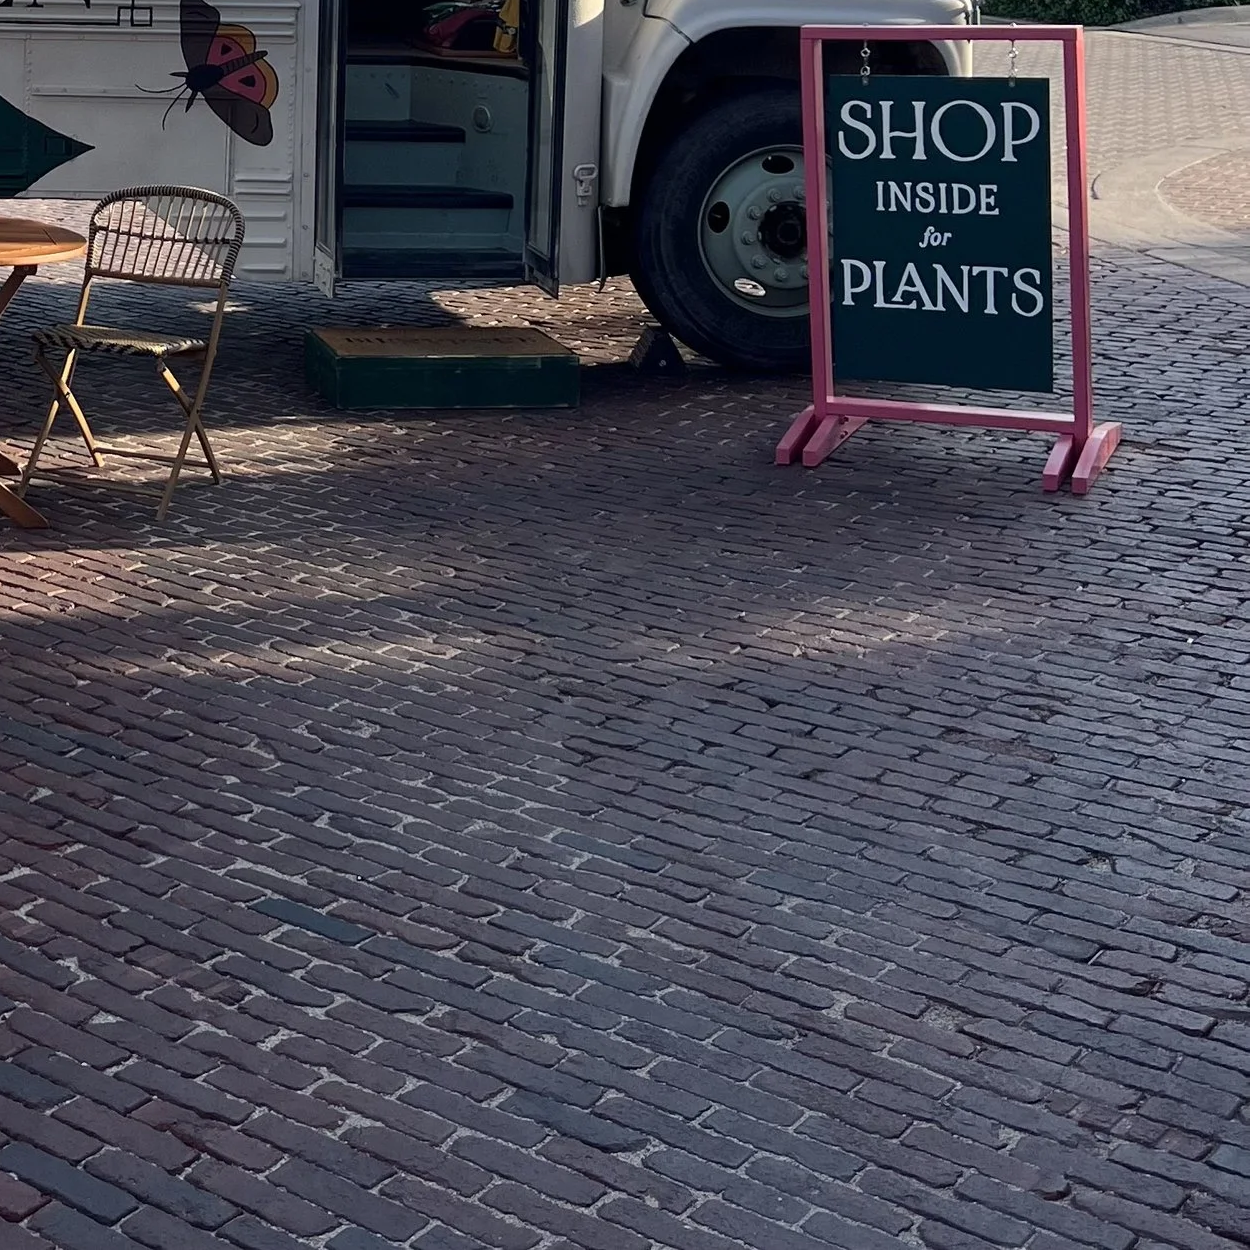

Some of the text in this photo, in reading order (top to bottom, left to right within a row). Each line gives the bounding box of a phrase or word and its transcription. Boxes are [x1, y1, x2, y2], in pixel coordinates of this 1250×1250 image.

[837, 99, 1041, 162] SHOP
[875, 180, 1000, 215] INSIDE
[918, 225, 953, 249] for
[840, 258, 1044, 317] PLANTS
